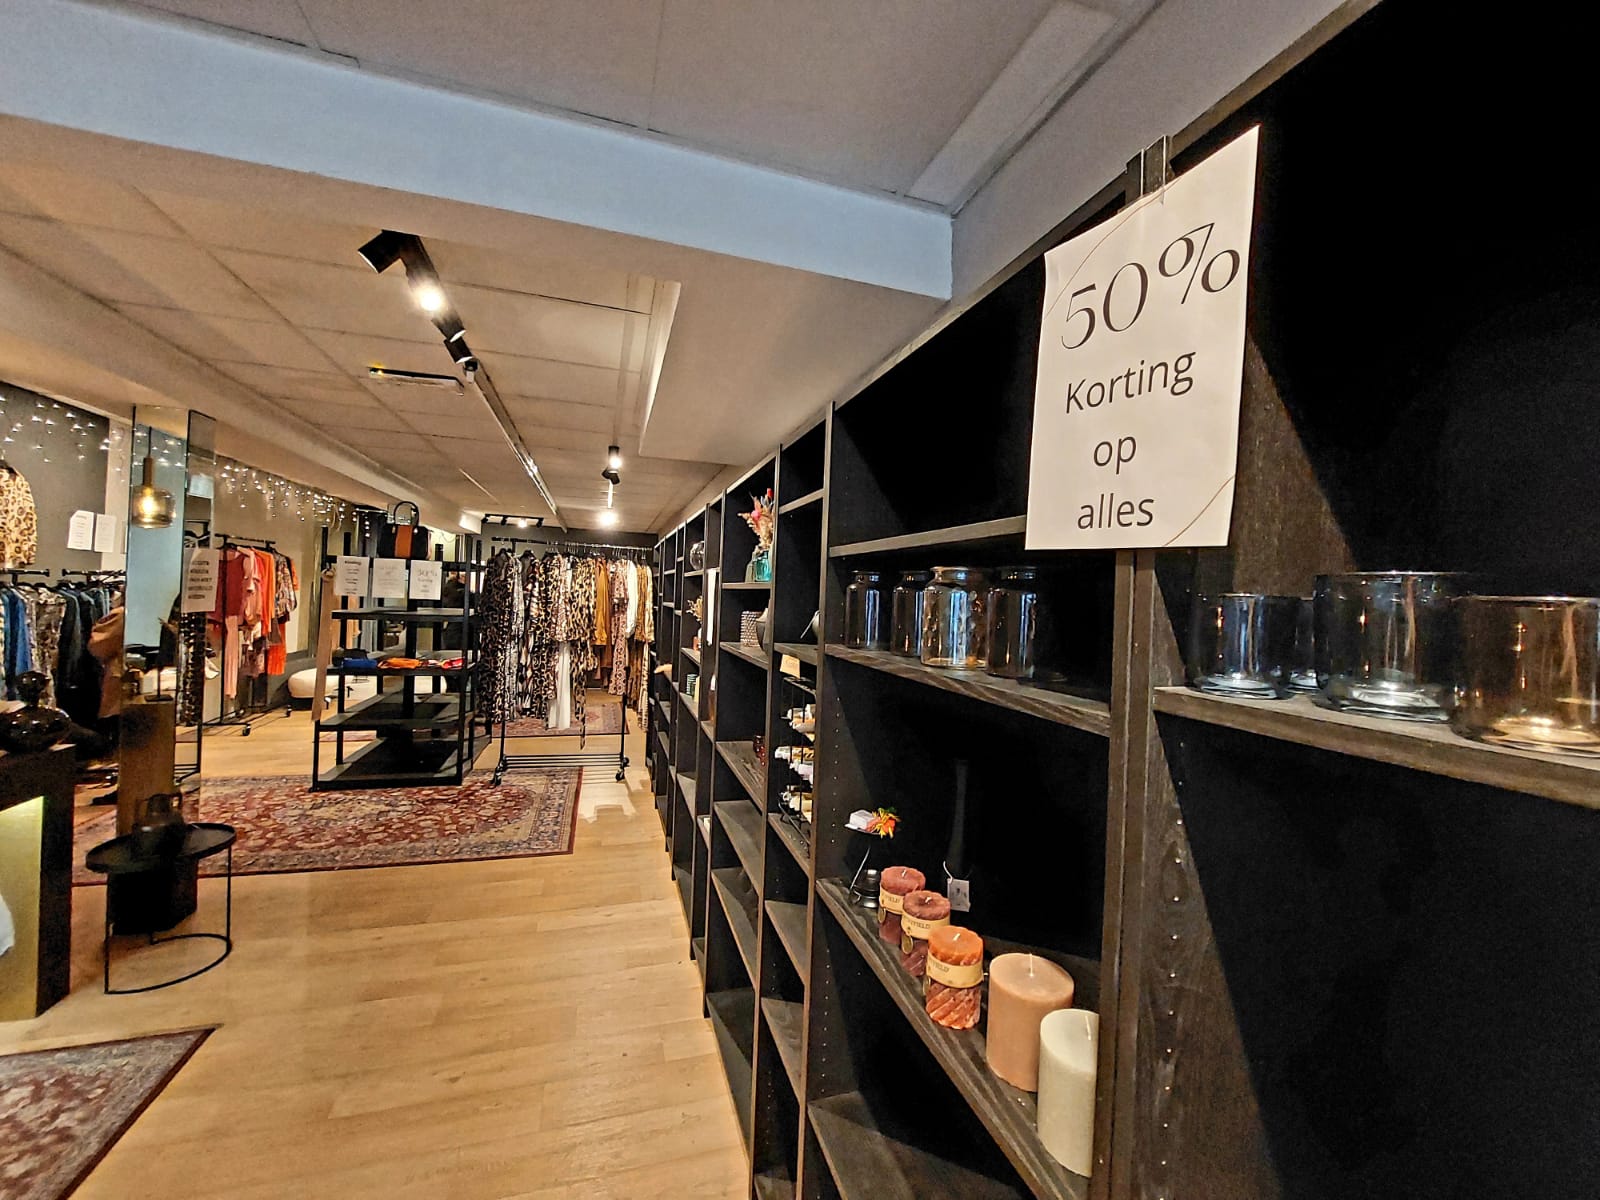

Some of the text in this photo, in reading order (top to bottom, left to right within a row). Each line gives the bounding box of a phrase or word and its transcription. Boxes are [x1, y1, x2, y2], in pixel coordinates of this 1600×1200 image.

[1060, 222, 1241, 351] 50%
[1065, 351, 1197, 415] Korting
[1093, 434, 1138, 475] op
[1077, 493, 1154, 530] alles
